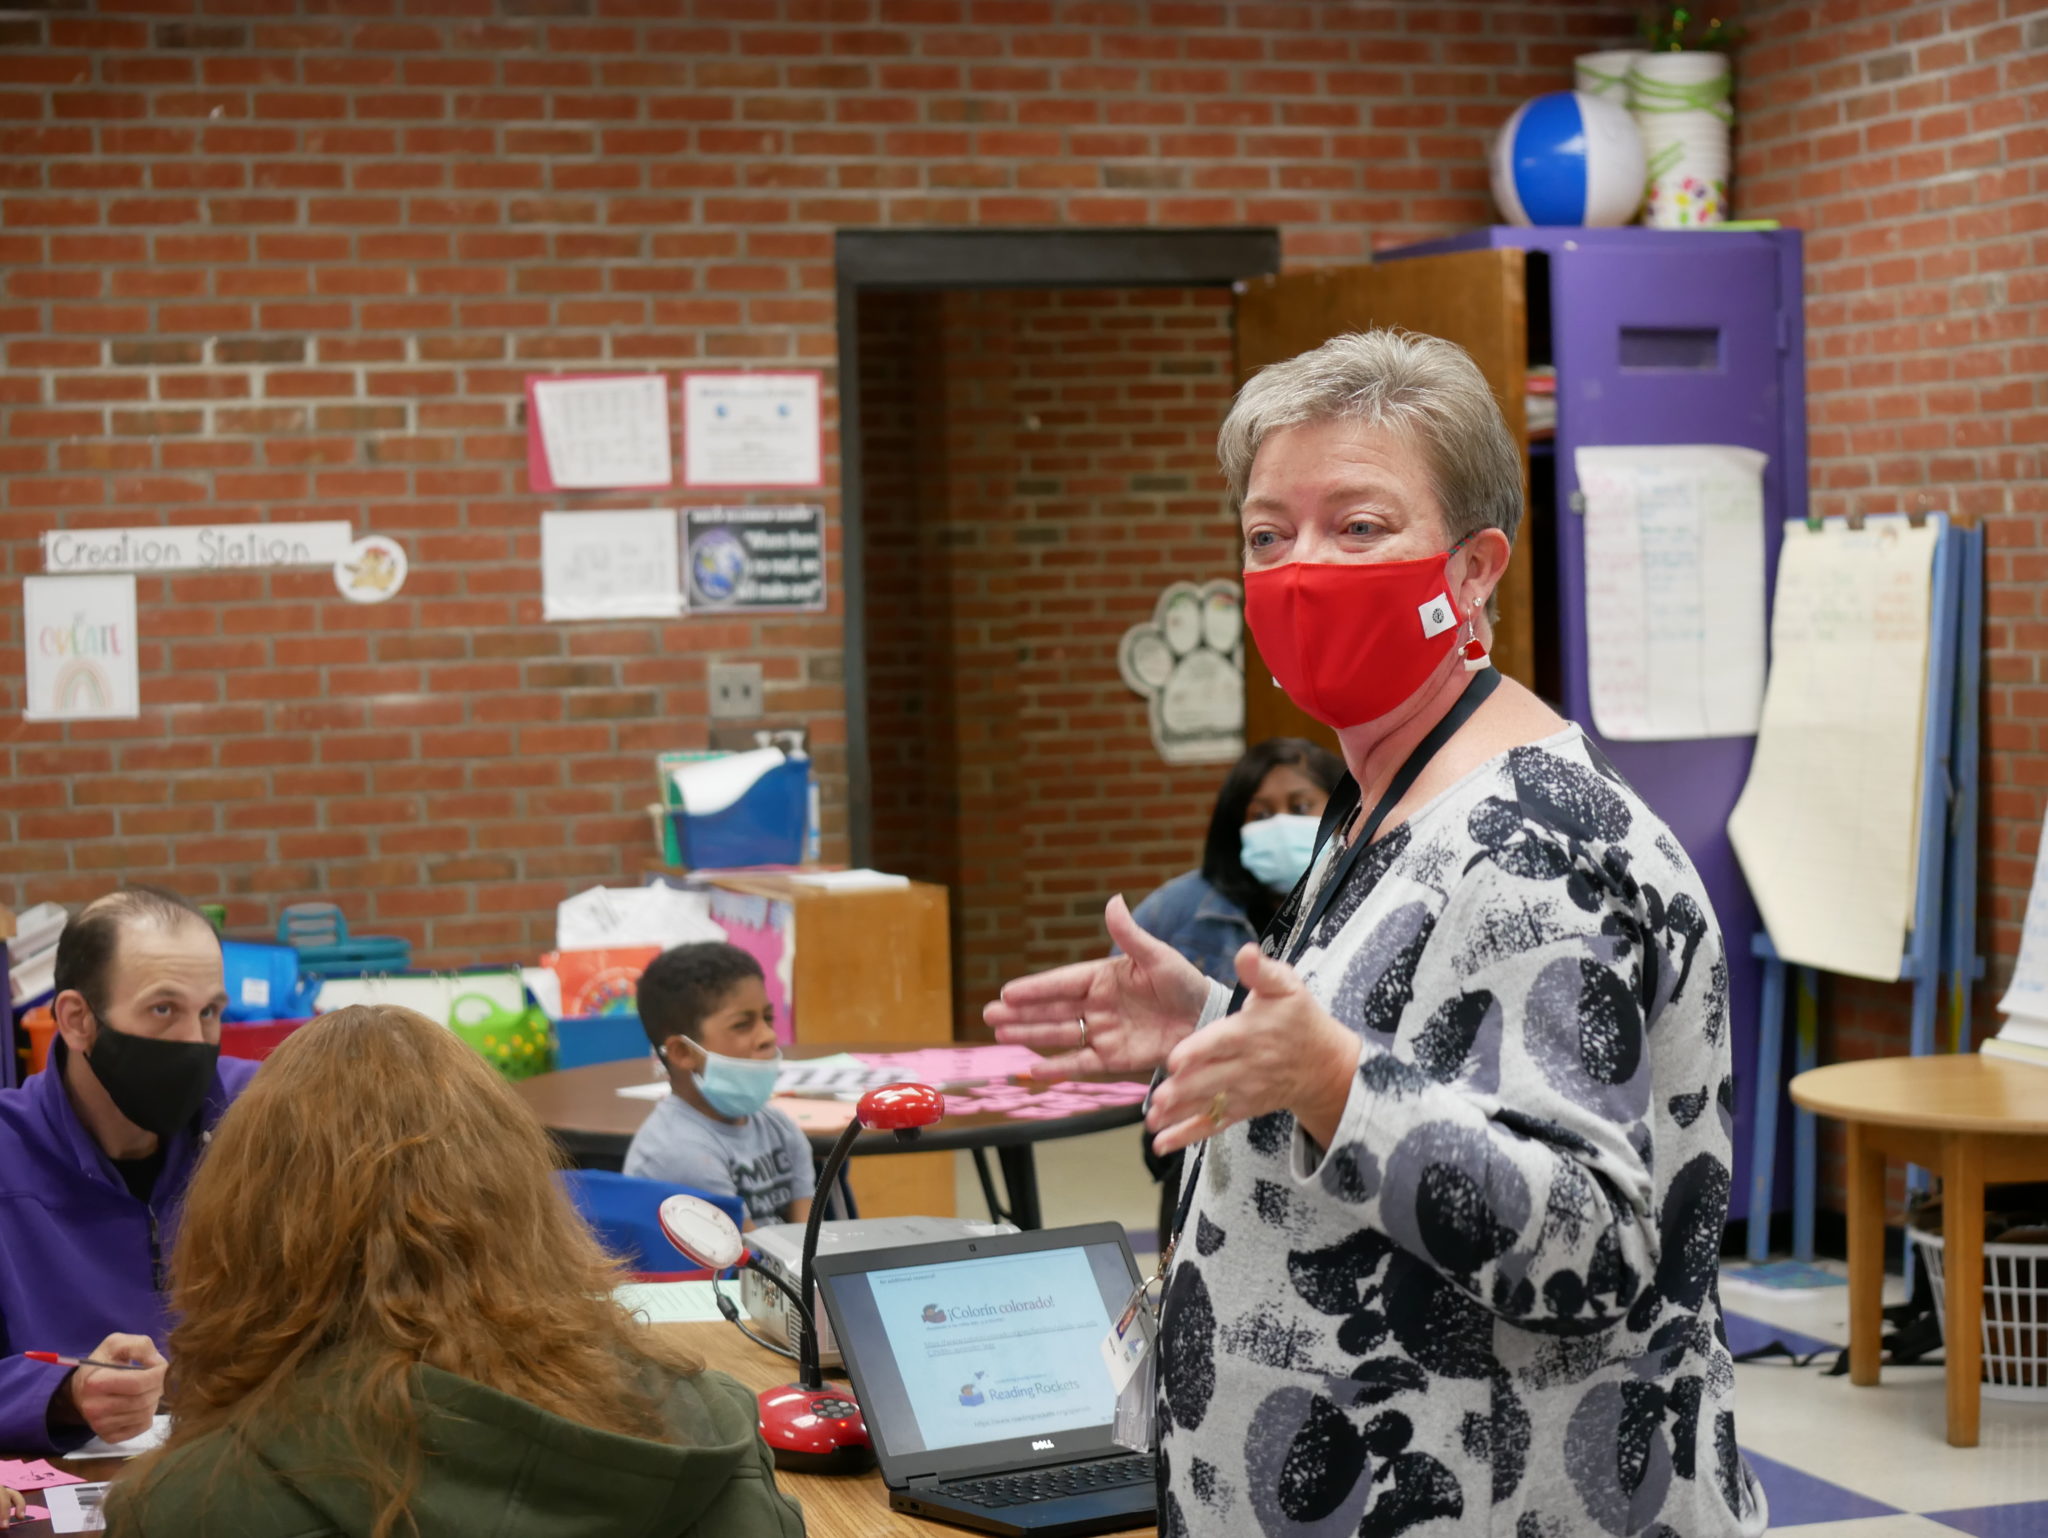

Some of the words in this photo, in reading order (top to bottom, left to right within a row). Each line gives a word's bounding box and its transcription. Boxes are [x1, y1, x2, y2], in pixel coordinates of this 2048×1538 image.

[52, 533, 182, 568] Creation
[198, 528, 311, 565] Station
[999, 1295, 1056, 1315] colorado!
[988, 1384, 1036, 1402] Reading
[1033, 1378, 1080, 1396] Rockets
[1031, 1438, 1055, 1451] DELL
